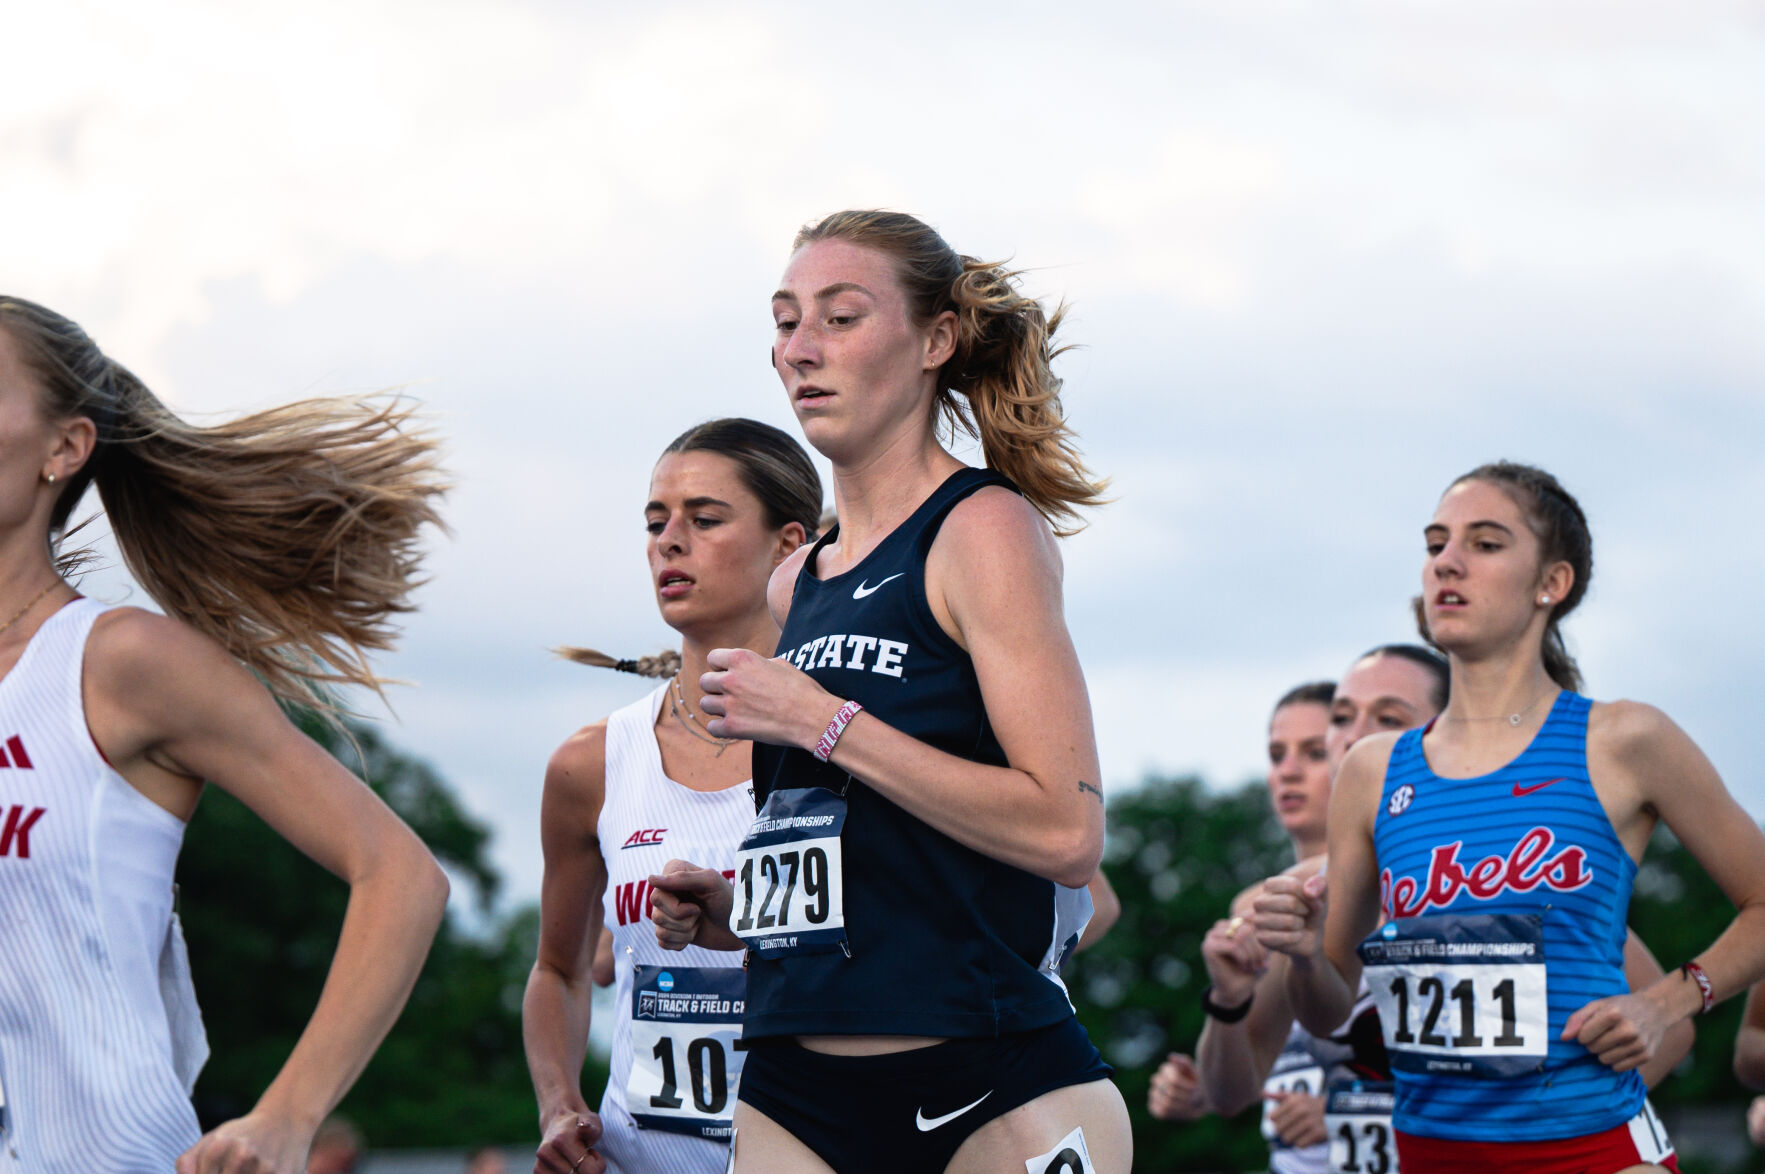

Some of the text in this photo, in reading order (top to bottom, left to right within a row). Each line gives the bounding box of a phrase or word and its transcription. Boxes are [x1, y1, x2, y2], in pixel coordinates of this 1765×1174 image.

[794, 634, 909, 678] STATE
[776, 815, 835, 831] CHAMPIONSHIPS
[624, 829, 668, 846] ACC
[736, 846, 830, 931] 1279
[760, 936, 798, 950] LEXINGTON, KY
[1447, 942, 1536, 957] CHAMPIONSHIPS
[658, 999, 689, 1012] TRACK
[690, 1000, 699, 1013] &
[700, 1000, 730, 1014] FIELD
[1390, 976, 1524, 1047] 1211
[1338, 1121, 1400, 1174] 13
